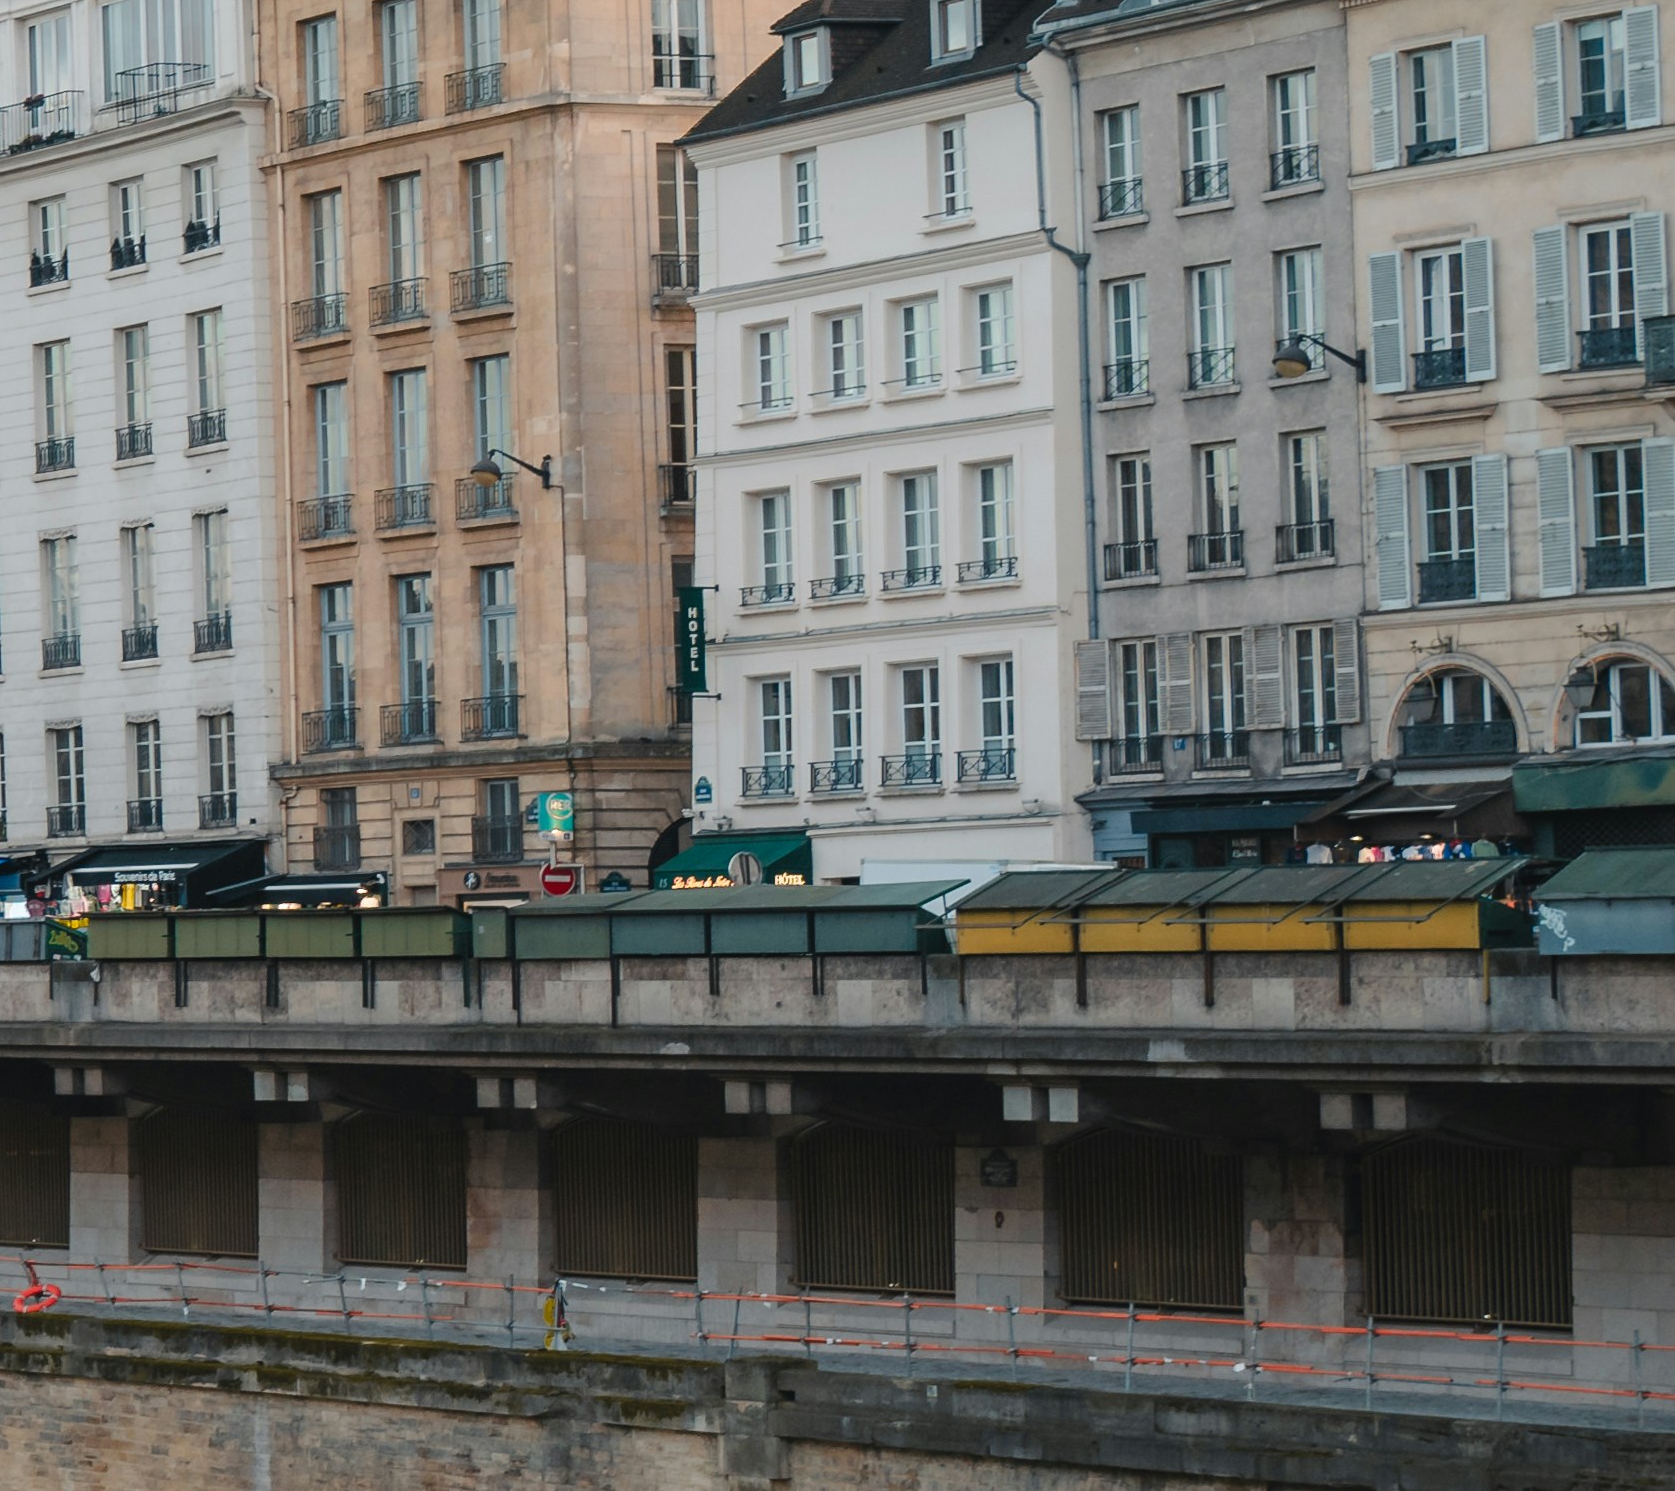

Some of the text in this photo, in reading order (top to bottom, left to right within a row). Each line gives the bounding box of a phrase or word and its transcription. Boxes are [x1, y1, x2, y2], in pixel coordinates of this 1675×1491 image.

[687, 607, 699, 672] HOTEL
[115, 870, 176, 882] Souvenirs de Paris
